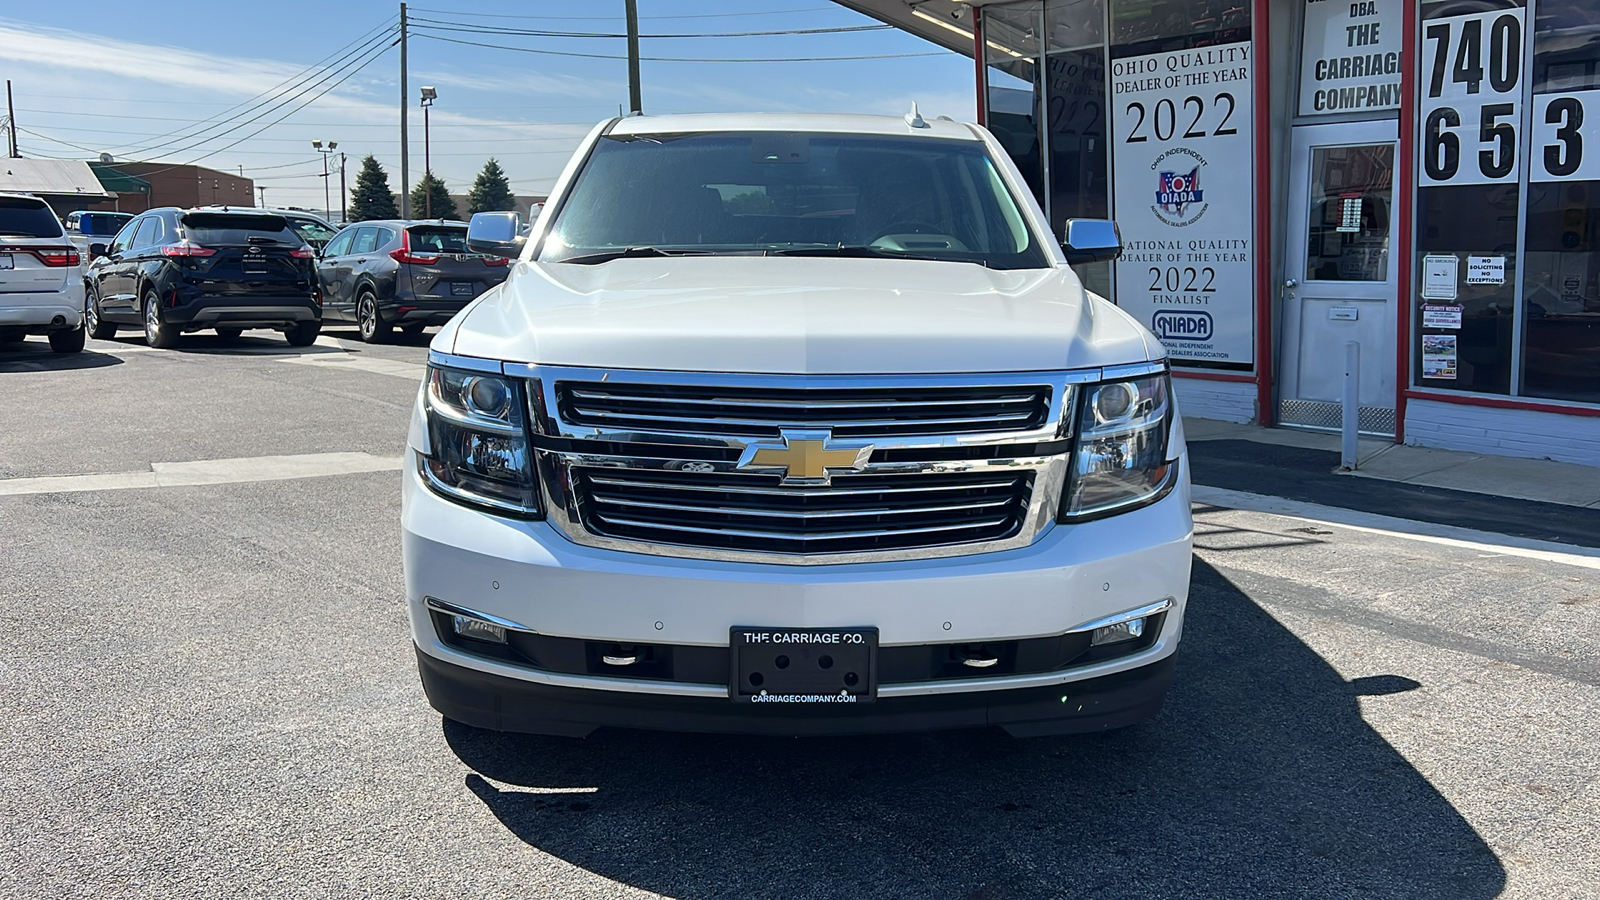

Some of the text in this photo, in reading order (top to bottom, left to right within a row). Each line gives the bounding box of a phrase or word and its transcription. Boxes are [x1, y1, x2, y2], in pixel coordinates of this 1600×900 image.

[1349, 1, 1379, 18] DBA.
[1346, 22, 1380, 47] THE
[1113, 58, 1158, 77] OHIO
[1166, 45, 1250, 72] QUALITY
[1426, 14, 1521, 98] 740
[1115, 79, 1162, 94] DEALER
[1164, 76, 1181, 88] OF
[1184, 73, 1210, 86] THE
[1213, 67, 1248, 82] YEAR
[1314, 83, 1402, 111] COMPANY
[1126, 92, 1238, 144] 2022
[1150, 147, 1209, 171] OHIO INDEPENDENT
[1161, 191, 1195, 203] OIADA
[1188, 239, 1249, 251] QUALITY
[1119, 252, 1247, 262] DEALER OF THE YEAR
[1148, 266, 1217, 292] 2022
[1153, 294, 1210, 305] FINALIST
[1157, 316, 1207, 339] NIADA
[1194, 351, 1229, 359] ASSOCIATION
[743, 633, 865, 644] THE CARRIAGE CO.
[751, 695, 857, 703] CARRIAGECOMPANY.COM
